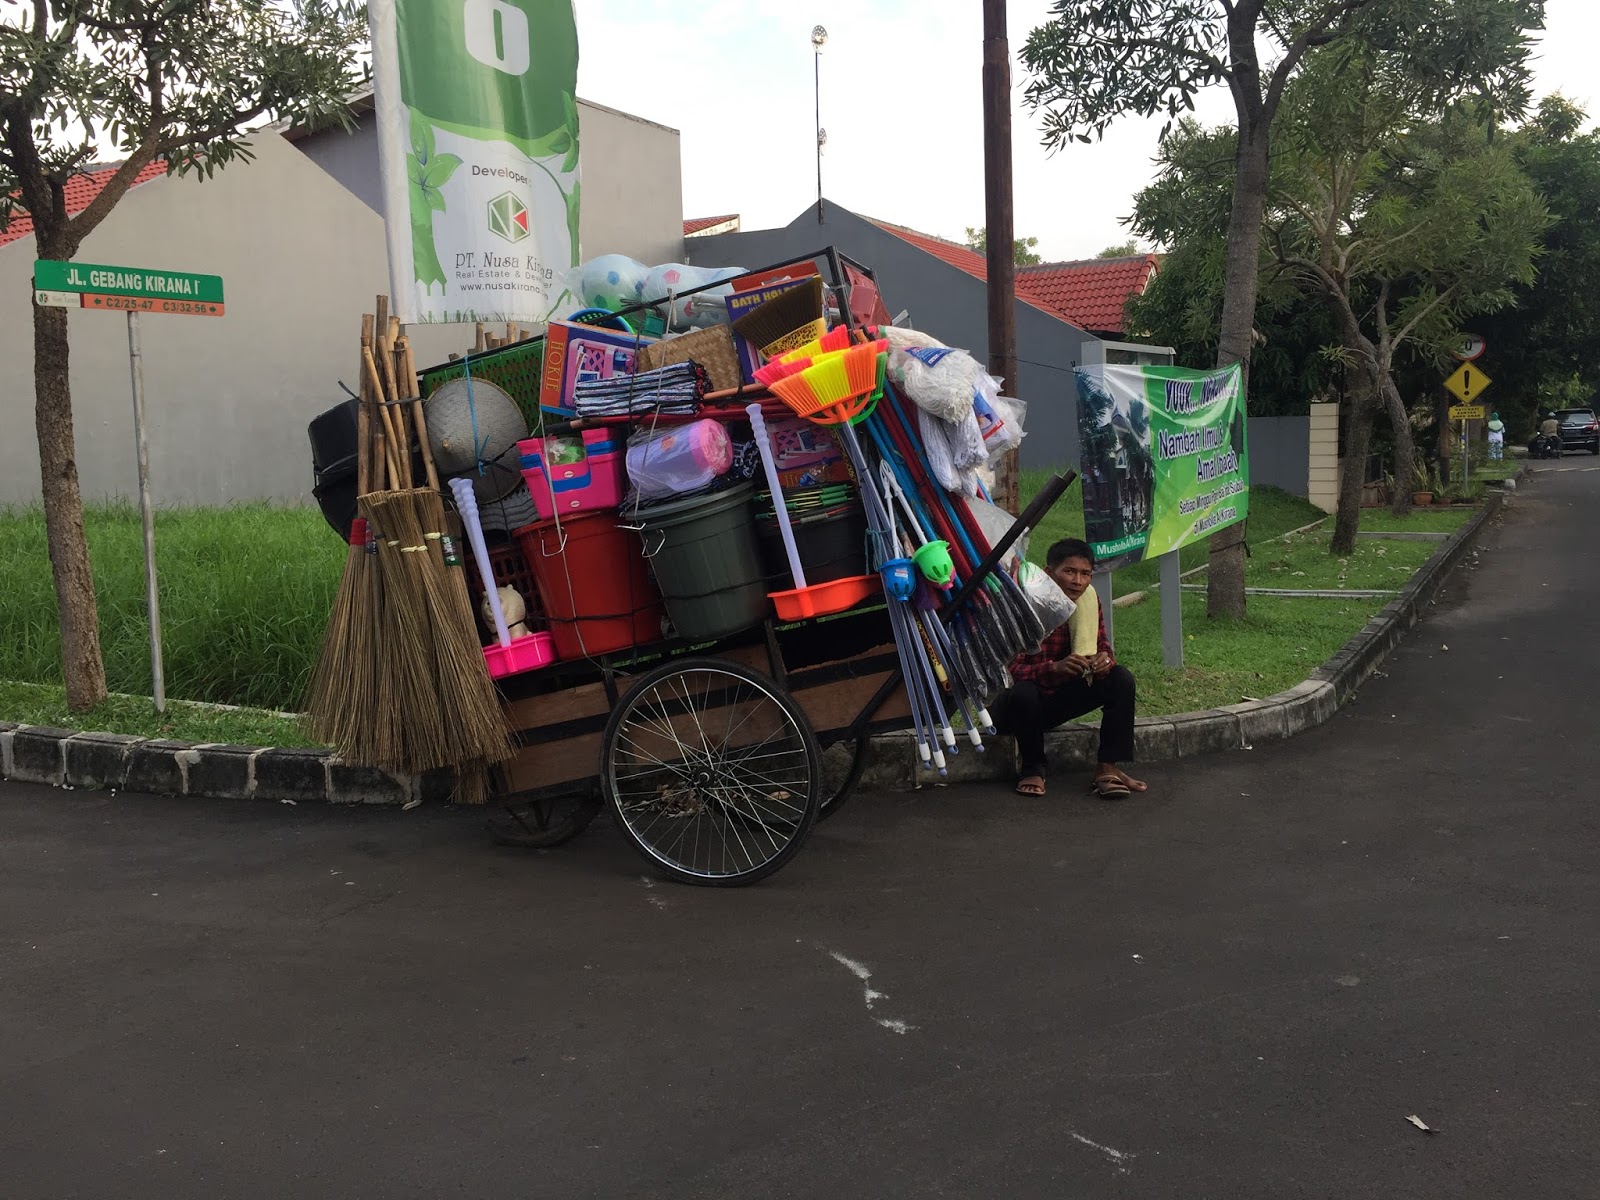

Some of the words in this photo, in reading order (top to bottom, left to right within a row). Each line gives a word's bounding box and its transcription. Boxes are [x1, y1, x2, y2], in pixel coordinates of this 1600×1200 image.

[455, 252, 476, 269] PT.
[483, 252, 519, 268] Nusa
[67, 268, 87, 285] JL.
[90, 270, 143, 290] GEBANG
[145, 275, 192, 295] KIRANA
[455, 270, 475, 279] Real
[478, 269, 510, 278] Estate
[514, 270, 520, 278] &
[106, 297, 153, 310] C2/25-47
[163, 301, 206, 313] C3/32-56
[731, 292, 761, 309] BATH
[545, 340, 566, 393] HOKIE
[1158, 426, 1201, 460] Nambah
[1197, 451, 1217, 484] Amal
